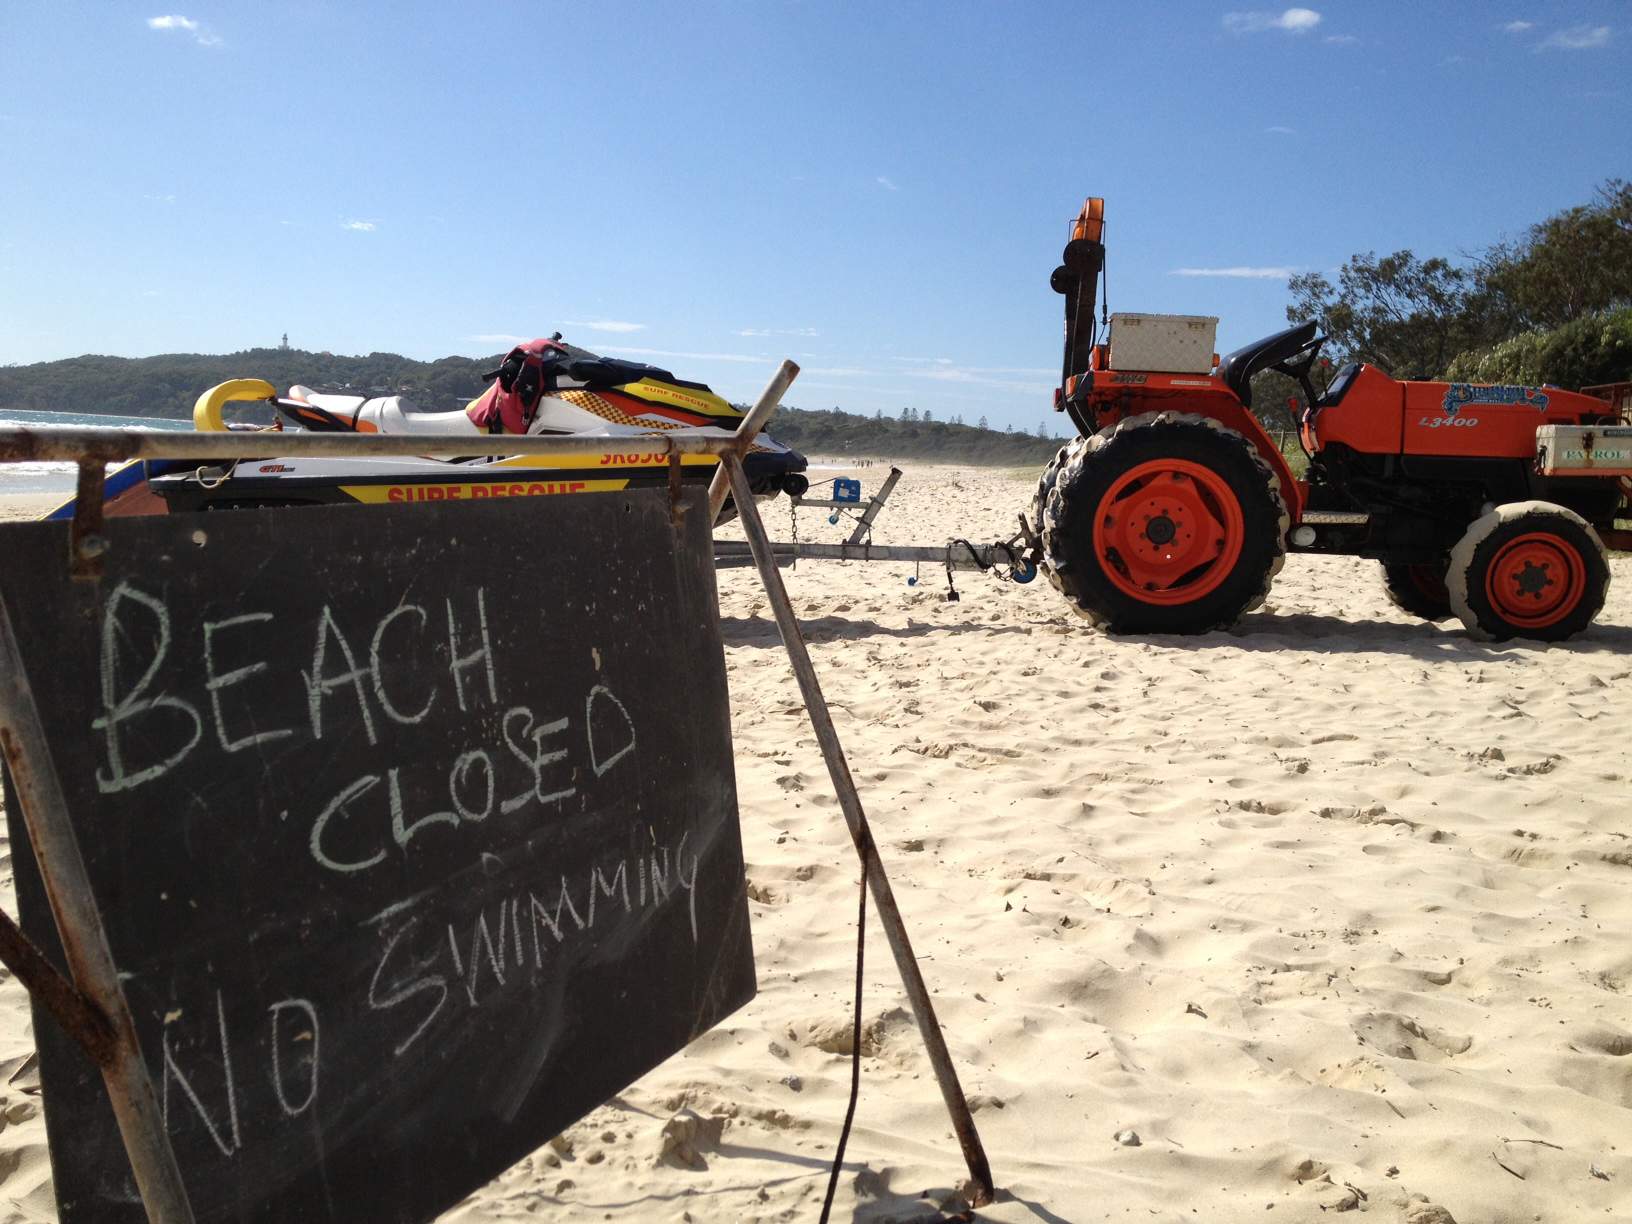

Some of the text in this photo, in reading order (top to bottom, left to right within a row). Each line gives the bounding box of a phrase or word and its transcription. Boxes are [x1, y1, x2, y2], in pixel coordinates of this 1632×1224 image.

[642, 385, 711, 410] SURF RESCUE
[1418, 416, 1479, 429] L3400
[92, 581, 498, 794] BEACH
[308, 684, 637, 873] CLOSED
[161, 830, 699, 1158] NO SWIMMING
